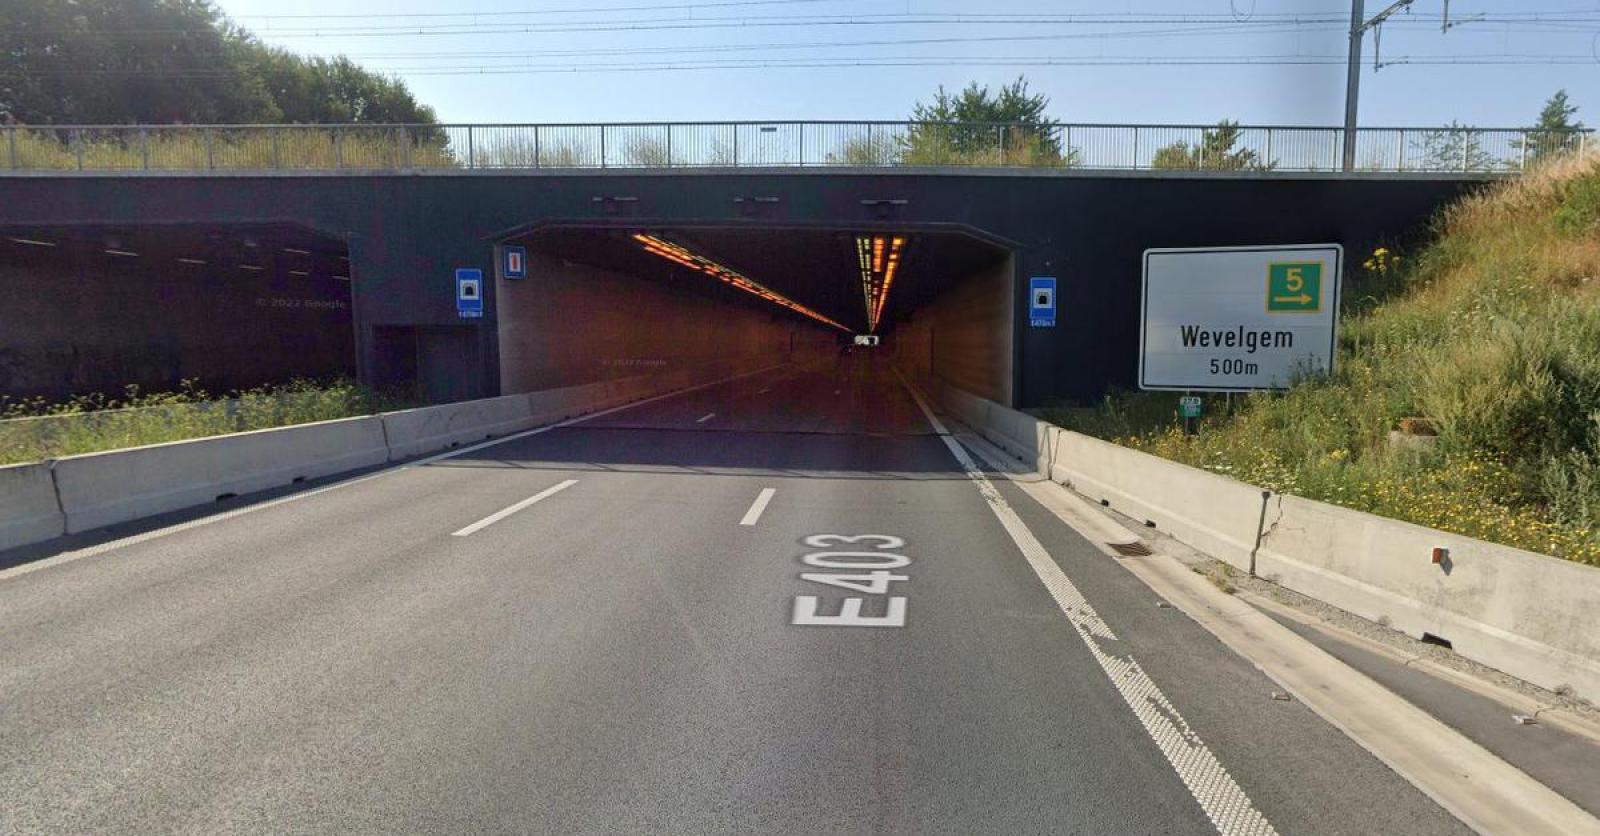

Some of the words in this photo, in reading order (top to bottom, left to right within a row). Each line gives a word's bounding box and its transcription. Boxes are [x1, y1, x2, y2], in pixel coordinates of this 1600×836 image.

[1286, 268, 1303, 291] 5
[1181, 325, 1293, 353] Wevelgem
[1210, 359, 1258, 375] 500m
[792, 534, 912, 627] E403
